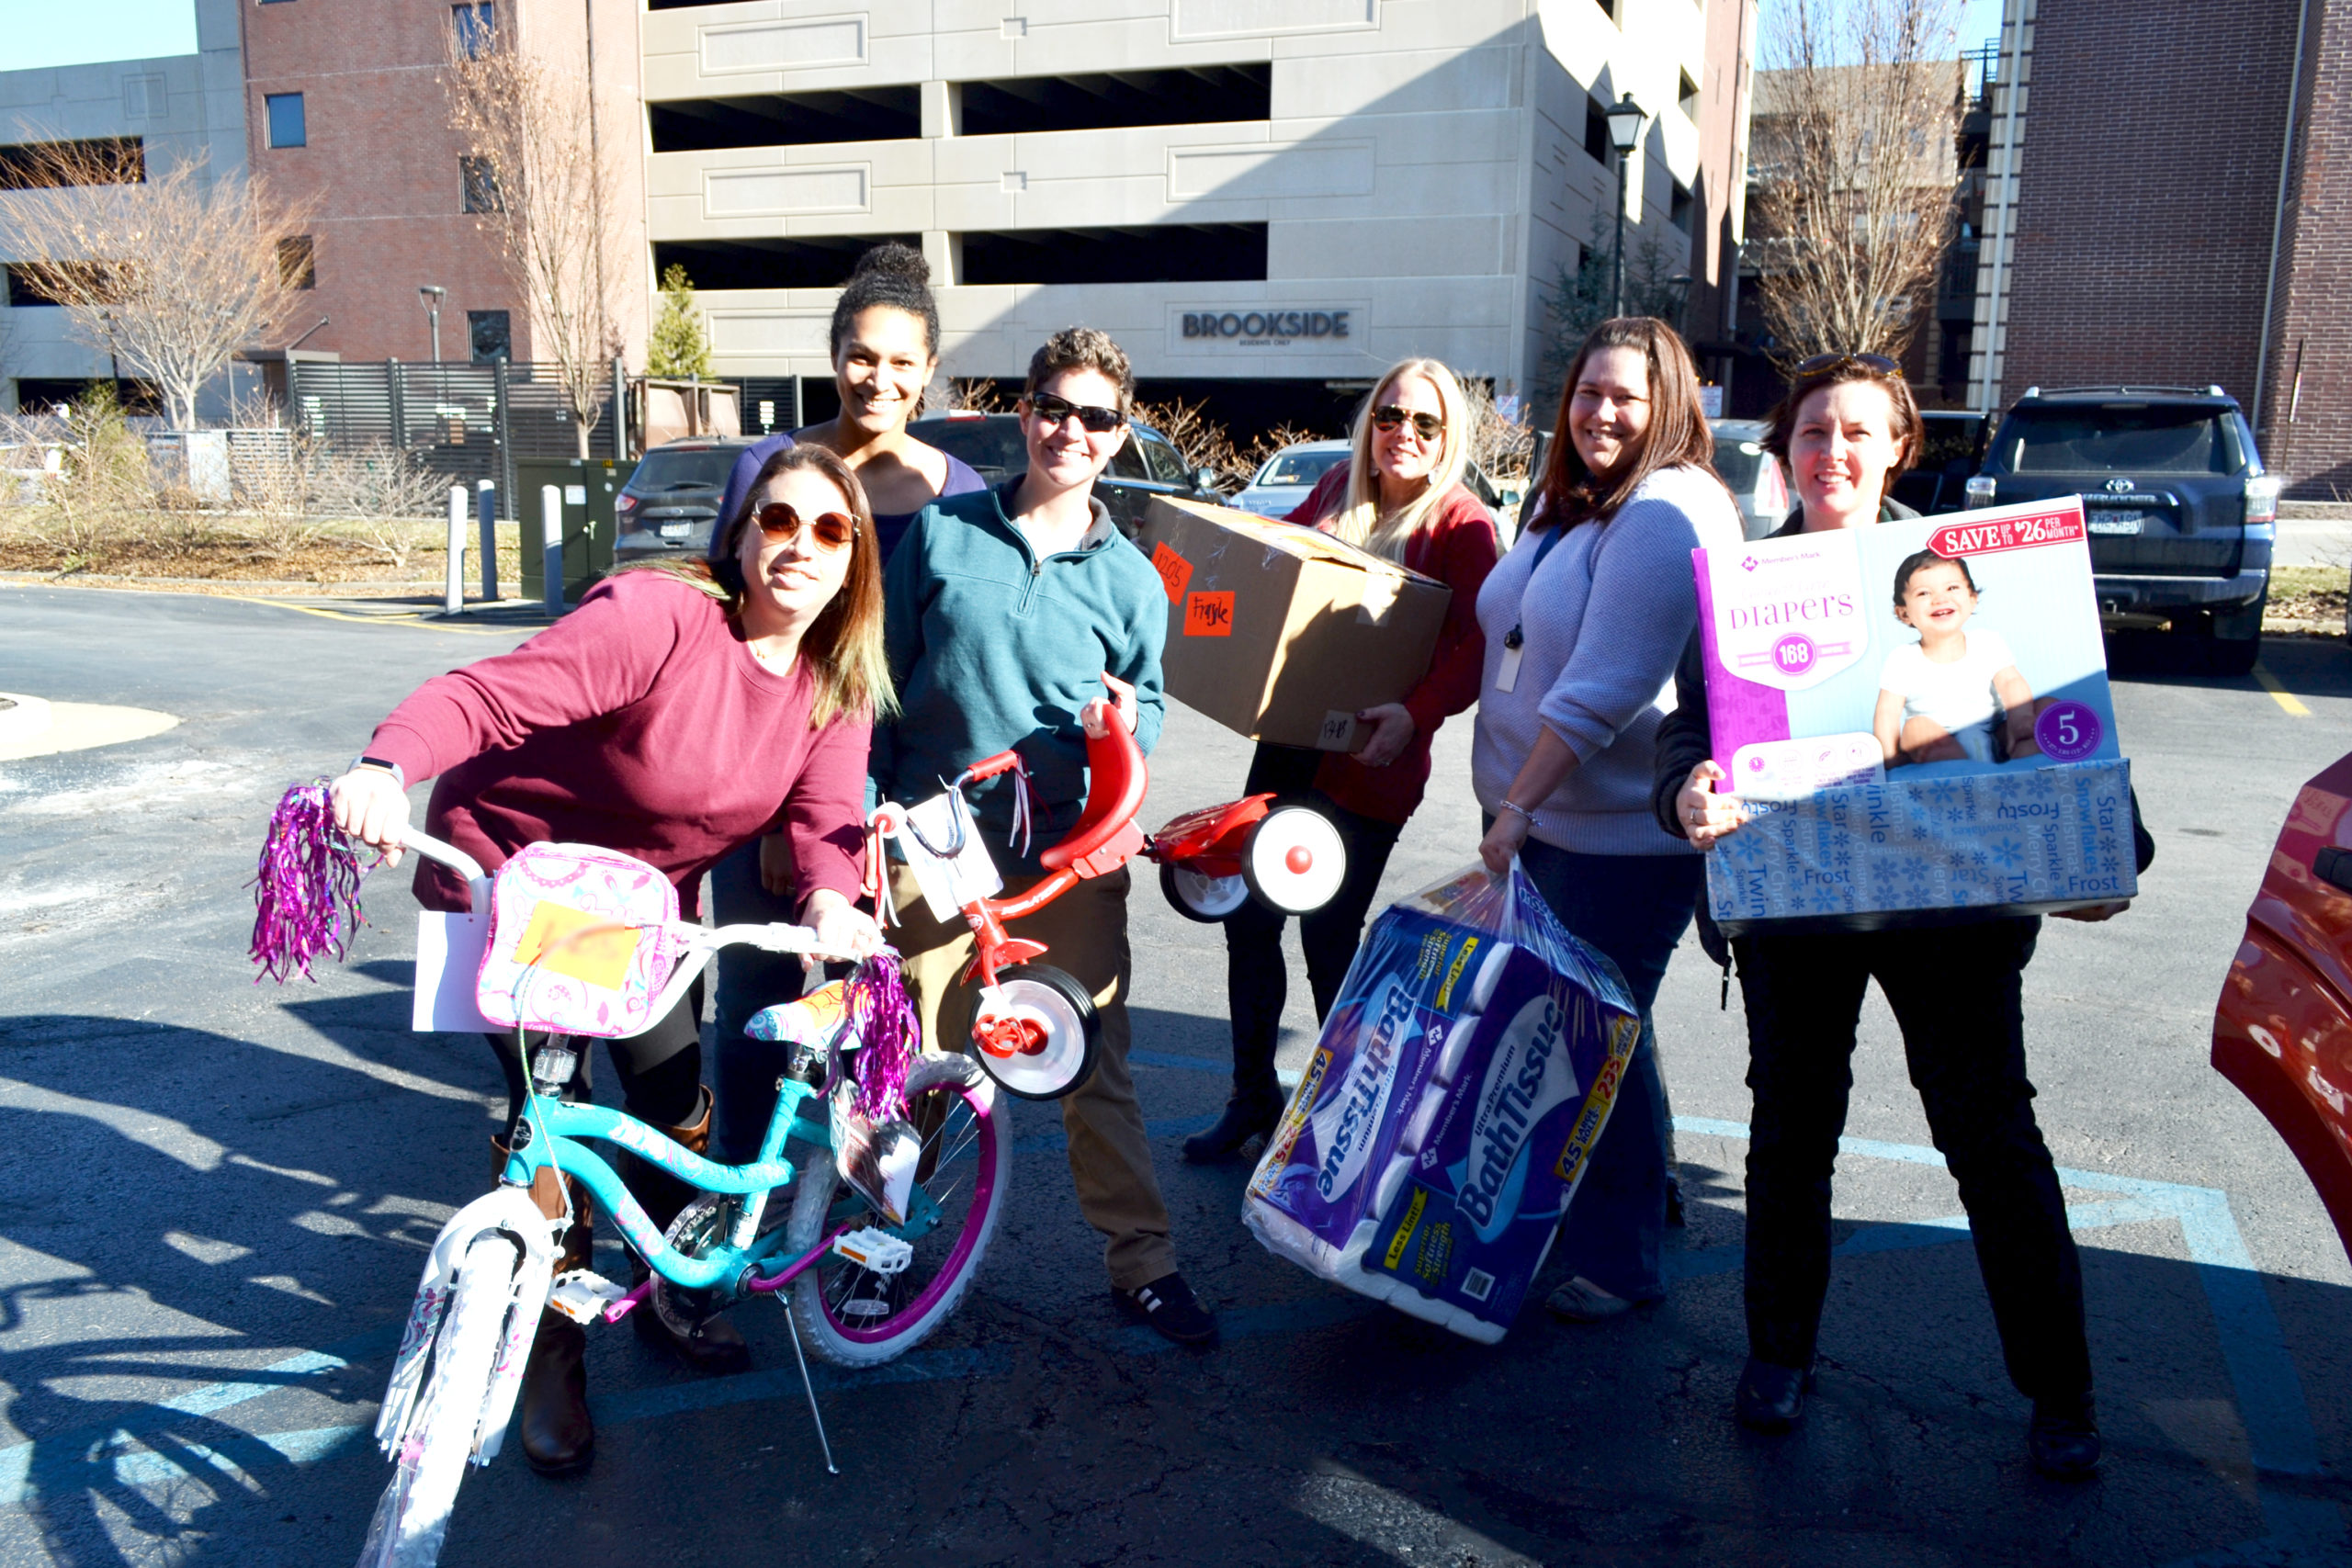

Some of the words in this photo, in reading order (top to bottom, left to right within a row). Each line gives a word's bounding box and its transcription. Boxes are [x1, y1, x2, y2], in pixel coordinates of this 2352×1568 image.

[1182, 311, 1349, 337] BROOKSIDE
[2000, 524, 2011, 535] UP
[2015, 519, 2046, 543] $26
[2045, 517, 2061, 527] PER
[1801, 551, 1821, 559] Mark
[1945, 525, 2001, 553] SAVE
[2003, 535, 2014, 545] TO
[1157, 553, 1182, 587] 1205
[1779, 642, 1809, 665] 168
[2059, 710, 2079, 745] 5
[1832, 793, 1849, 829] Star
[1996, 802, 2061, 820] Frosty
[2075, 777, 2100, 875] Snowflakes
[2097, 796, 2117, 834] Star
[1781, 818, 1801, 874] Sparkle
[2026, 824, 2041, 873] Merry
[2060, 792, 2081, 874] Christmas
[2041, 822, 2064, 882] Sparkle
[1748, 864, 1769, 917] Twin
[1804, 868, 1850, 885] Frost
[1932, 854, 1947, 901] Merry
[1951, 866, 1990, 885] Star
[2068, 875, 2120, 893] Frost
[1310, 1051, 1328, 1084] 45
[1455, 1074, 1472, 1100] Mark
[1575, 1107, 1597, 1142] LARGE
[1562, 1142, 1582, 1178] 45
[1388, 1235, 1407, 1260] Less
[1422, 1222, 1442, 1280] Softness
